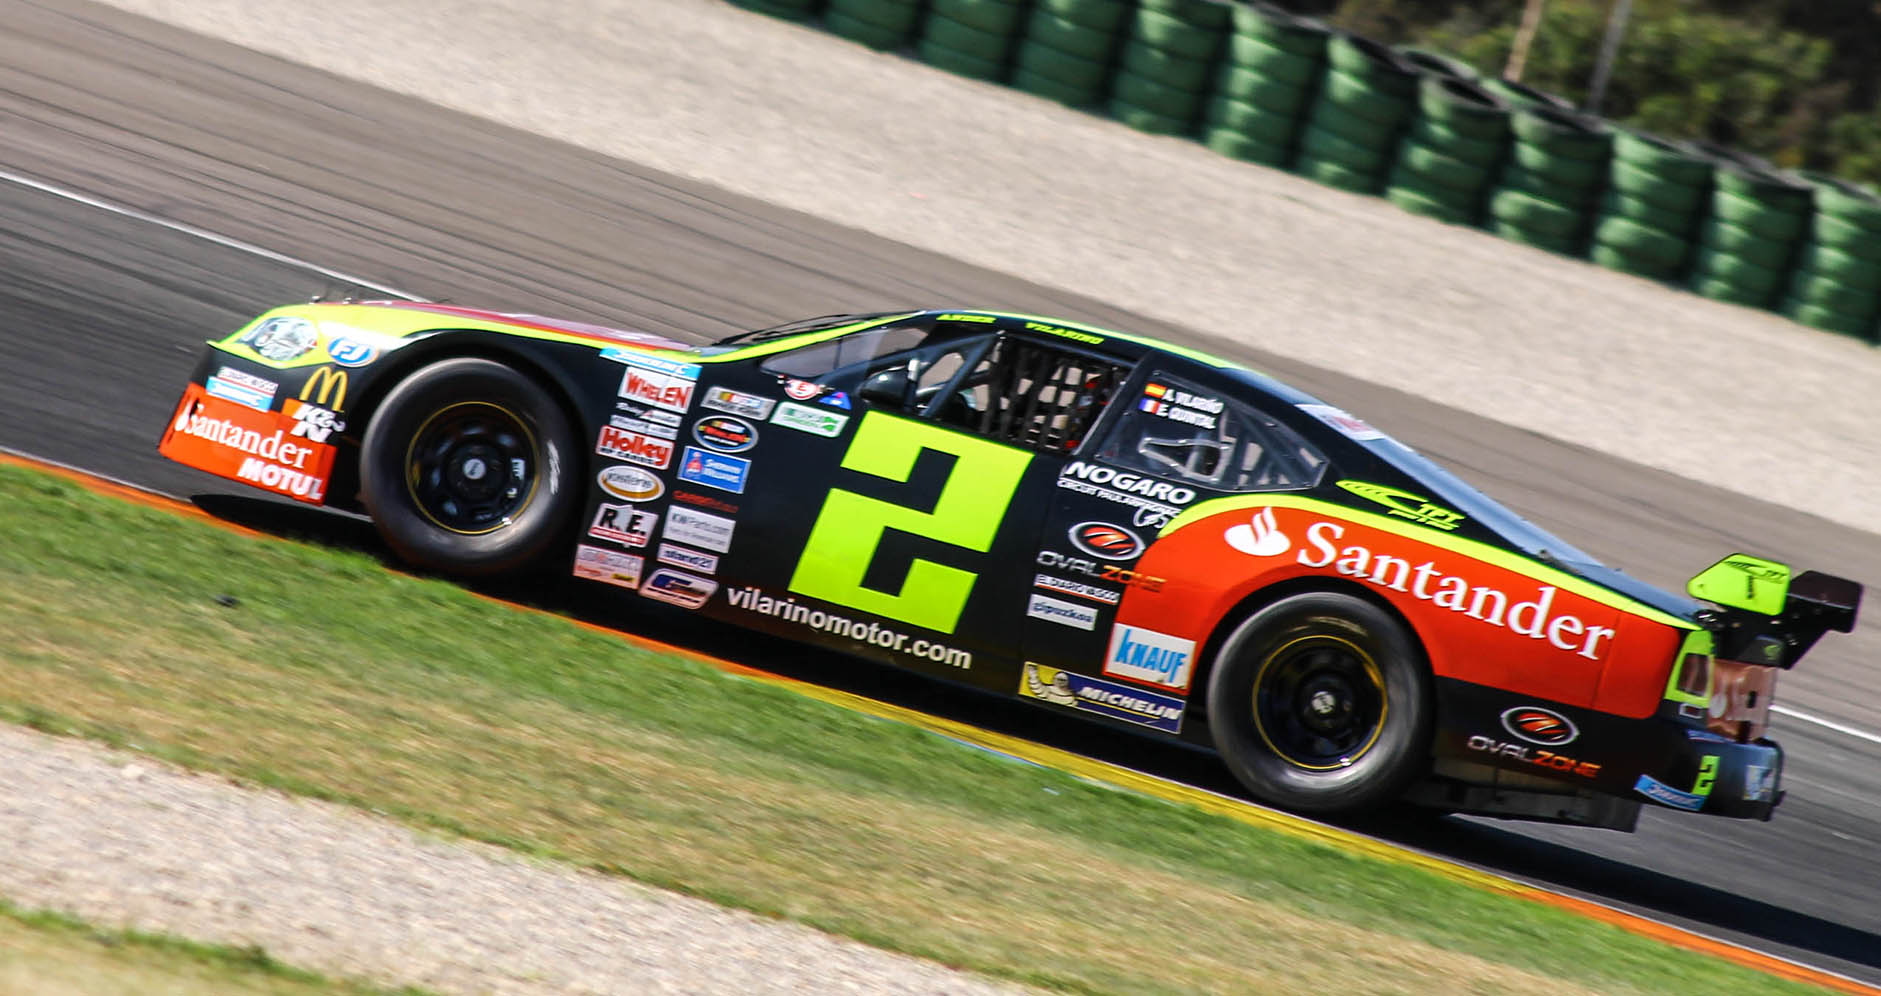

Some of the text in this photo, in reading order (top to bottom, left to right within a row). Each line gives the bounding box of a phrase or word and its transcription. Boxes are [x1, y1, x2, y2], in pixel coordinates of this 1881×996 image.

[626, 372, 693, 408] WHELEN
[186, 411, 312, 469] Santander
[602, 428, 669, 466] Holley
[237, 457, 324, 499] MOTUL
[1066, 461, 1196, 505] NOGARO
[788, 410, 1035, 634] 2
[1037, 551, 1167, 593] OVALZONE
[1296, 521, 1616, 660] Santander
[727, 586, 973, 670] vilarinomotor.com
[1115, 628, 1188, 683] KNAUF
[1076, 686, 1183, 721] MICHELIN
[1467, 736, 1601, 778] OVALZONE
[1692, 755, 1721, 796] 2
